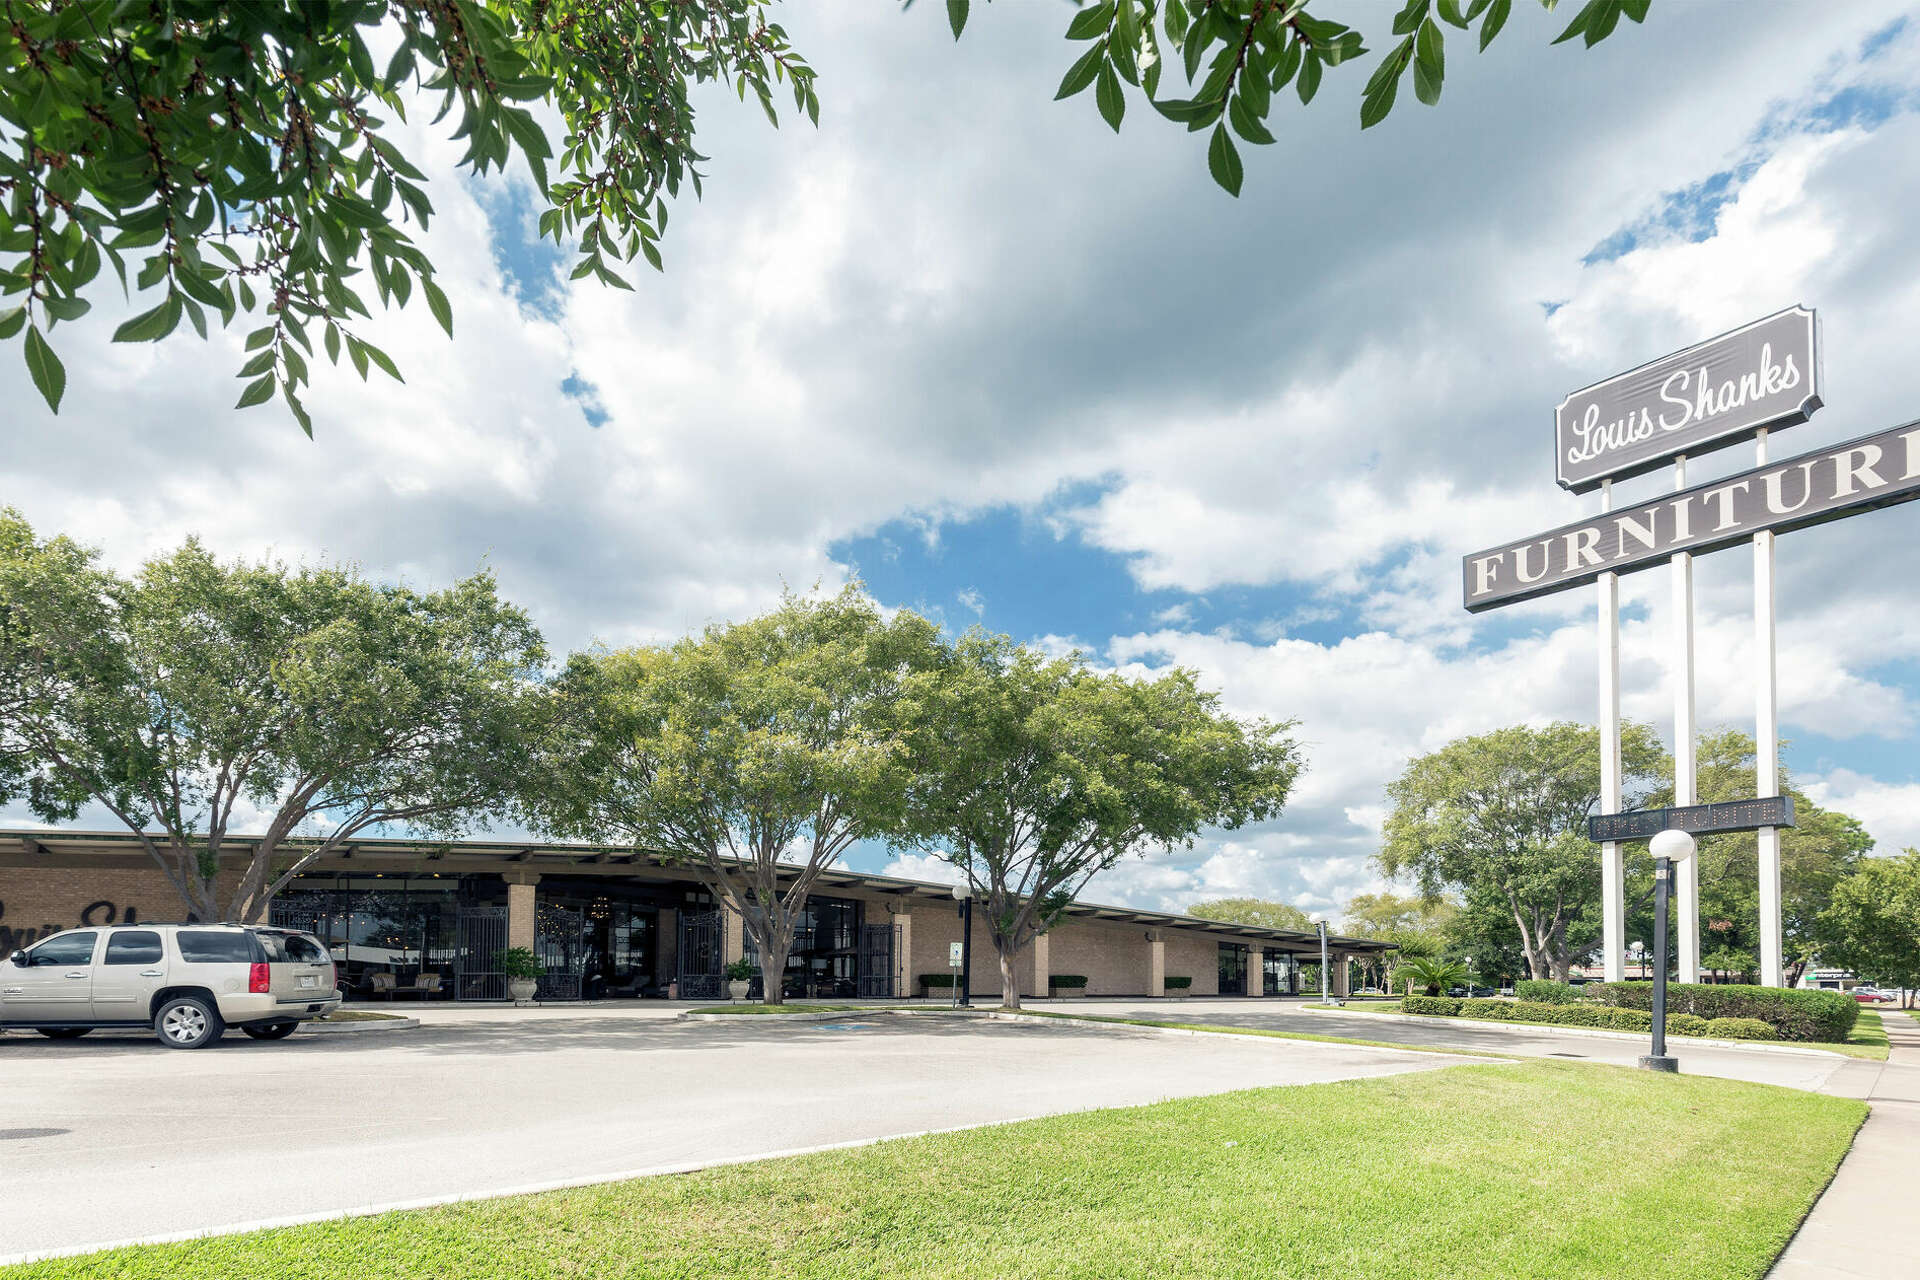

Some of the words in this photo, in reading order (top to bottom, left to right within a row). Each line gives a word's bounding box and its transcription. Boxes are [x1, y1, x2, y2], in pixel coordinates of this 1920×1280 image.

[1568, 404, 1653, 464] Louis
[1659, 343, 1800, 431] Shanks
[1672, 802, 1777, 830] TONITE
